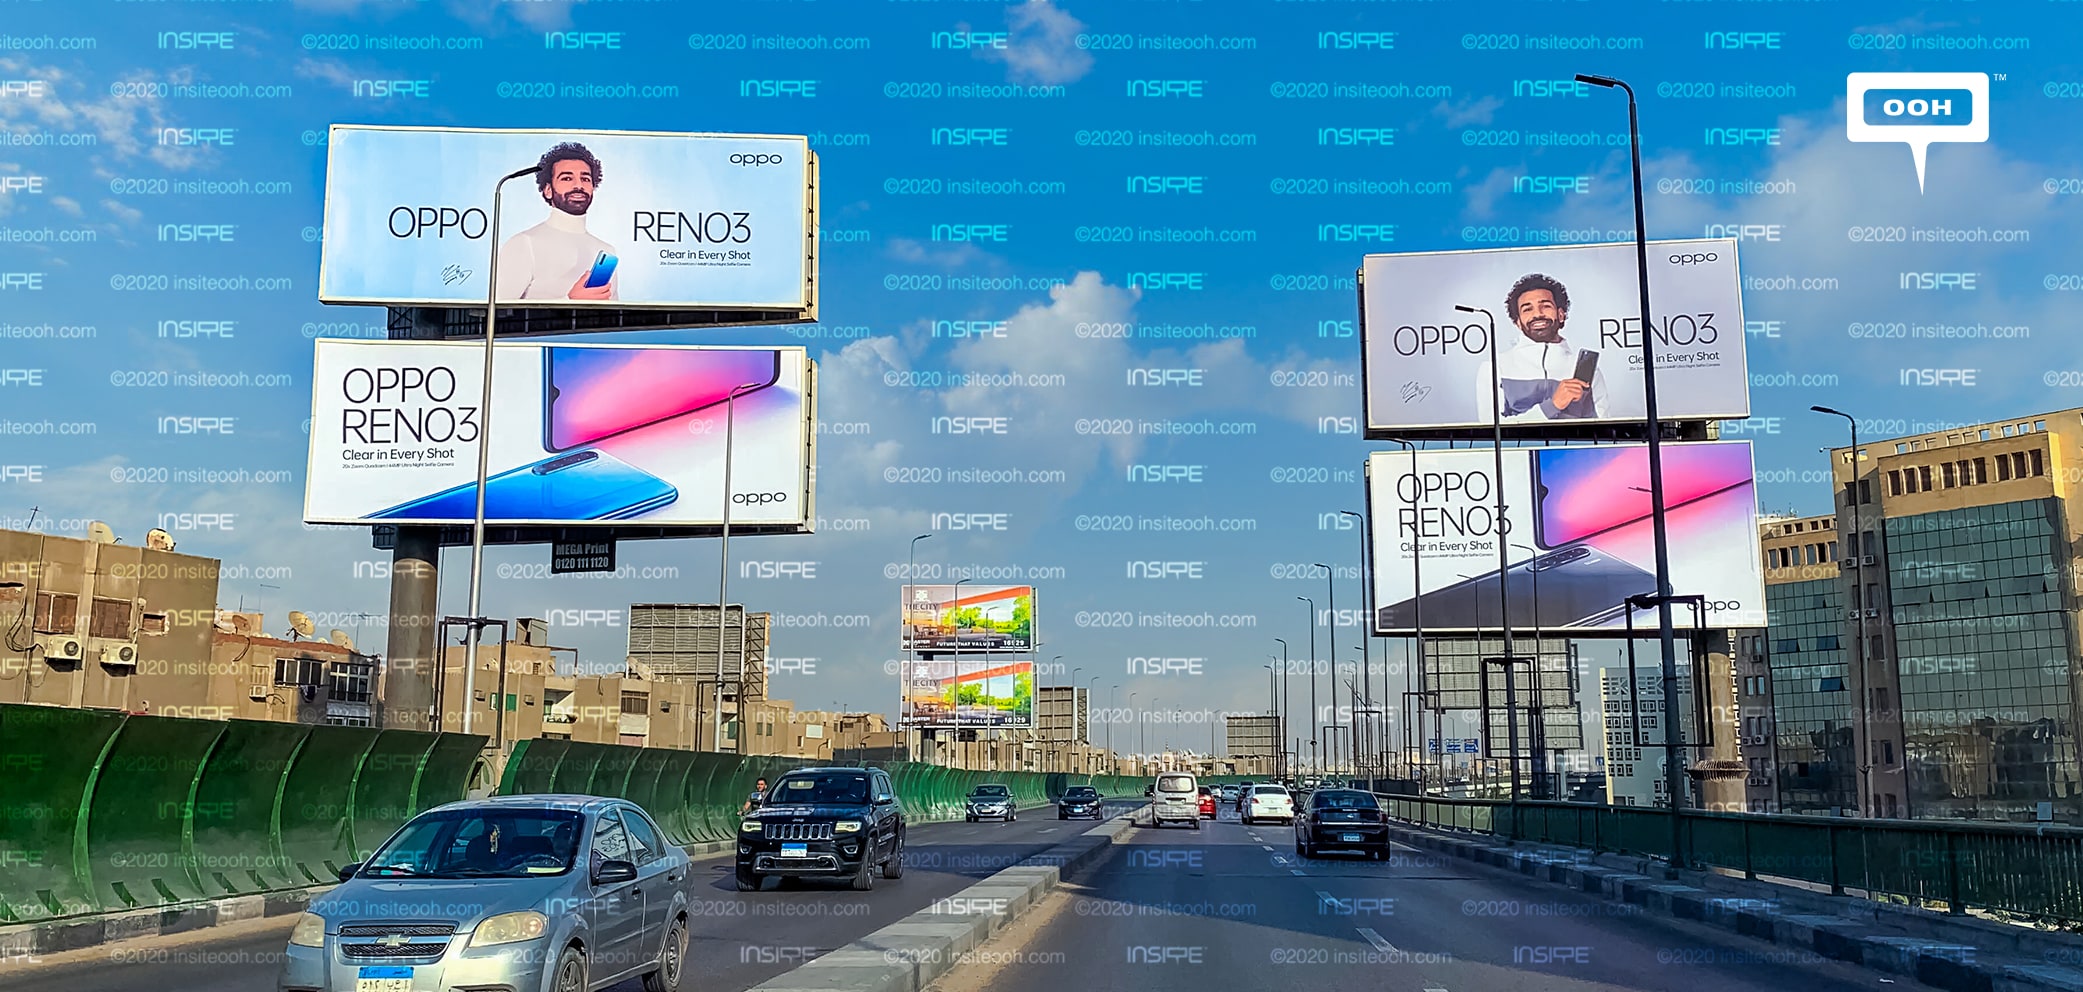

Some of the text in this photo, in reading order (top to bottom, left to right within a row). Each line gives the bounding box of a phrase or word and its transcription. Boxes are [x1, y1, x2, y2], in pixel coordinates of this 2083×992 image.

[729, 153, 783, 167] oppo
[389, 206, 488, 240] OPPO
[634, 211, 752, 244] RENO3
[660, 249, 751, 261] Clear in Every Shot
[1669, 252, 1718, 266] oppo
[1600, 313, 1718, 349] RENO3
[1394, 323, 1488, 357] OPPO
[1628, 351, 1720, 364] Cle in Every Shot
[343, 366, 456, 404] OPPO
[342, 406, 479, 444] RENO3
[342, 448, 454, 461] Clear in Every Shot
[1397, 470, 1490, 504] OPPO
[732, 491, 787, 507] oppo
[1399, 505, 1512, 538] RENO3
[556, 543, 609, 555] MEGA Print
[1400, 541, 1493, 552] Clear in Every Shot
[555, 556, 609, 569] 0120 111 1120
